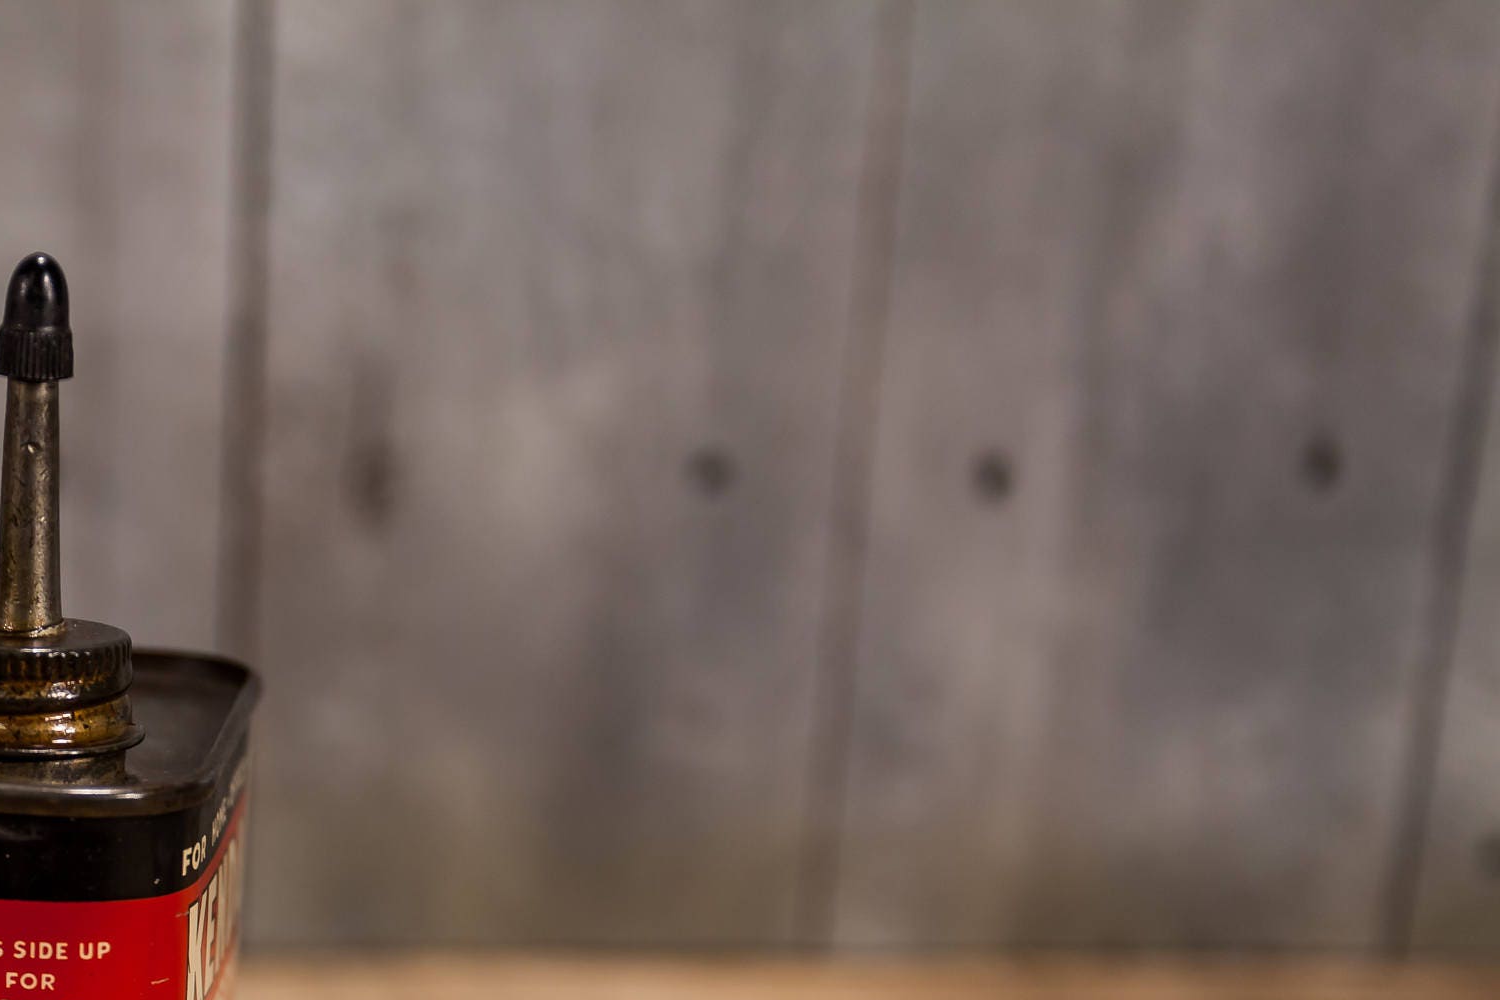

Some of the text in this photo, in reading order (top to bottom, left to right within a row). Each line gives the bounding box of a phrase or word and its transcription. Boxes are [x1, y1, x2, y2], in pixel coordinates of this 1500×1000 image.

[182, 834, 207, 877] FOR
[13, 940, 69, 960] SIDE
[79, 941, 111, 960] UP
[5, 971, 56, 991] FOR
